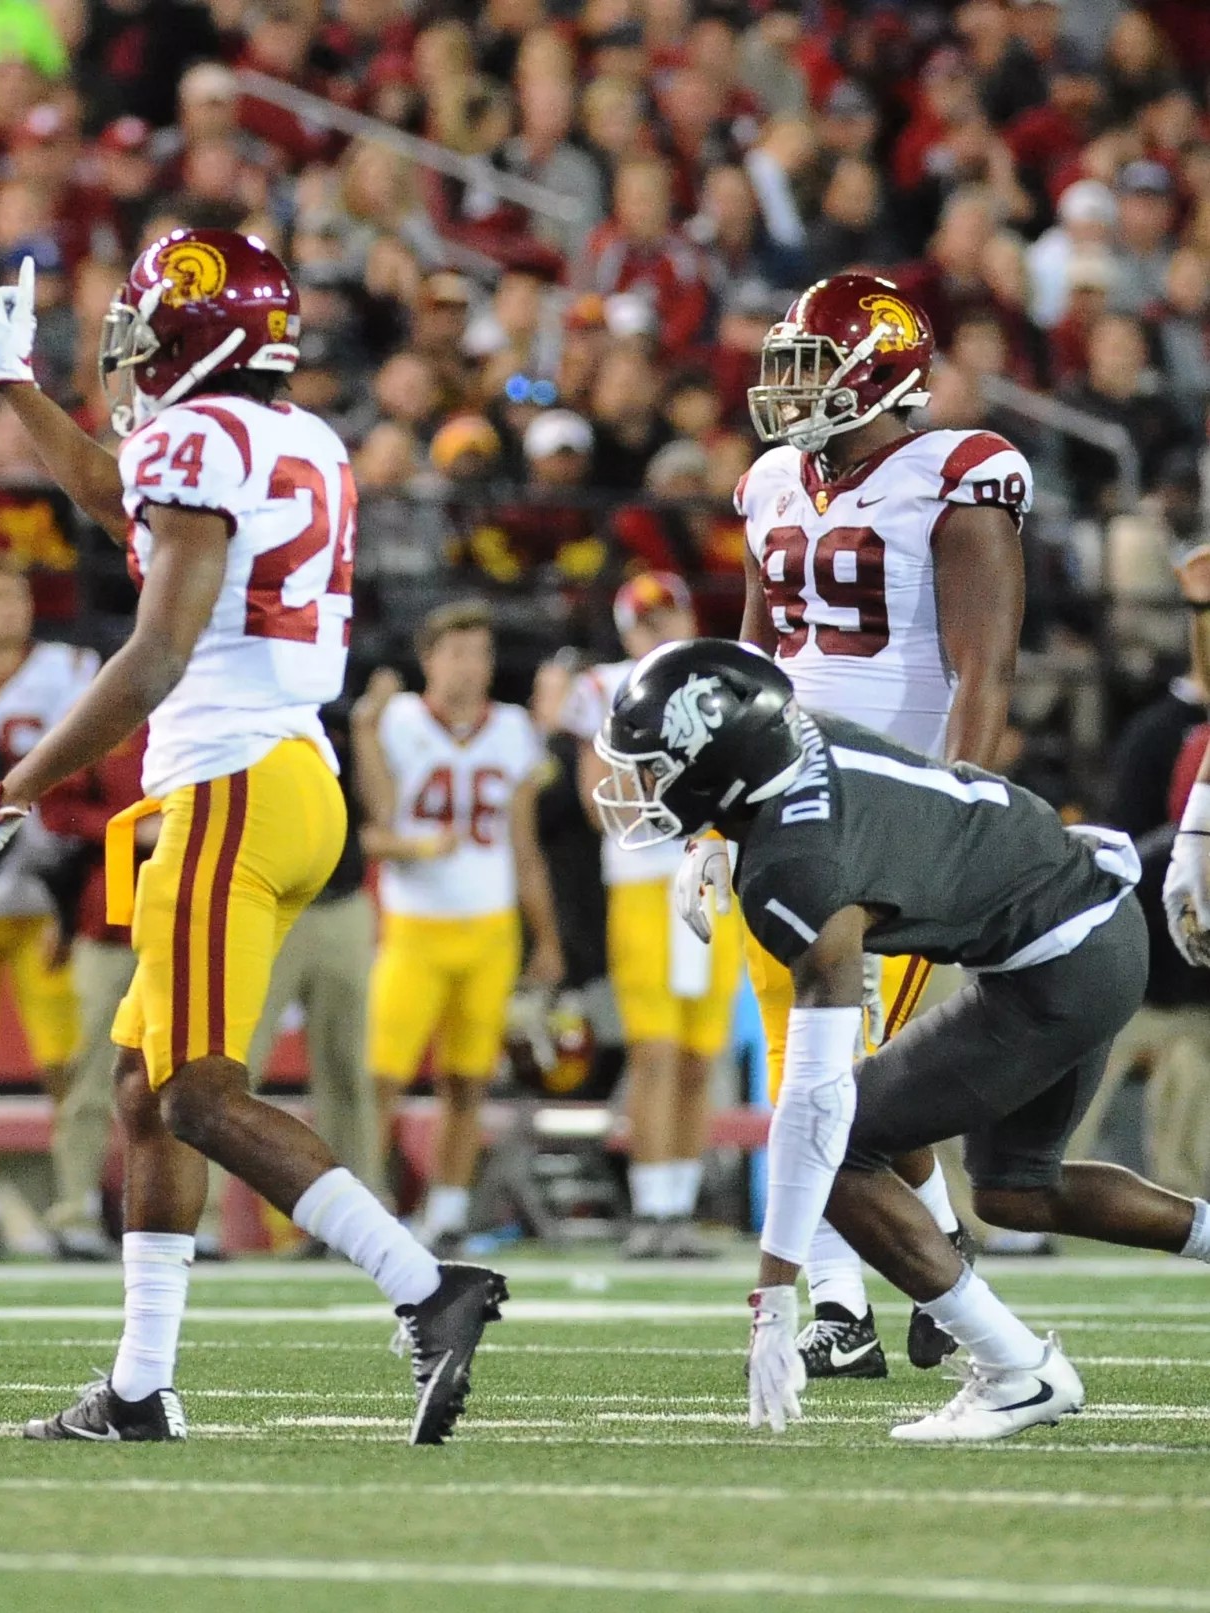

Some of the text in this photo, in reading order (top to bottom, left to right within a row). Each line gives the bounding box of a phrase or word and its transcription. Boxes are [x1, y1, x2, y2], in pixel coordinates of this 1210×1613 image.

[136, 432, 206, 487] 24
[244, 455, 358, 647] 24
[761, 525, 891, 658] 89
[413, 766, 503, 845] 46
[829, 745, 1010, 807] 1
[764, 898, 819, 945] 1
[159, 1391, 187, 1439] NIKE
